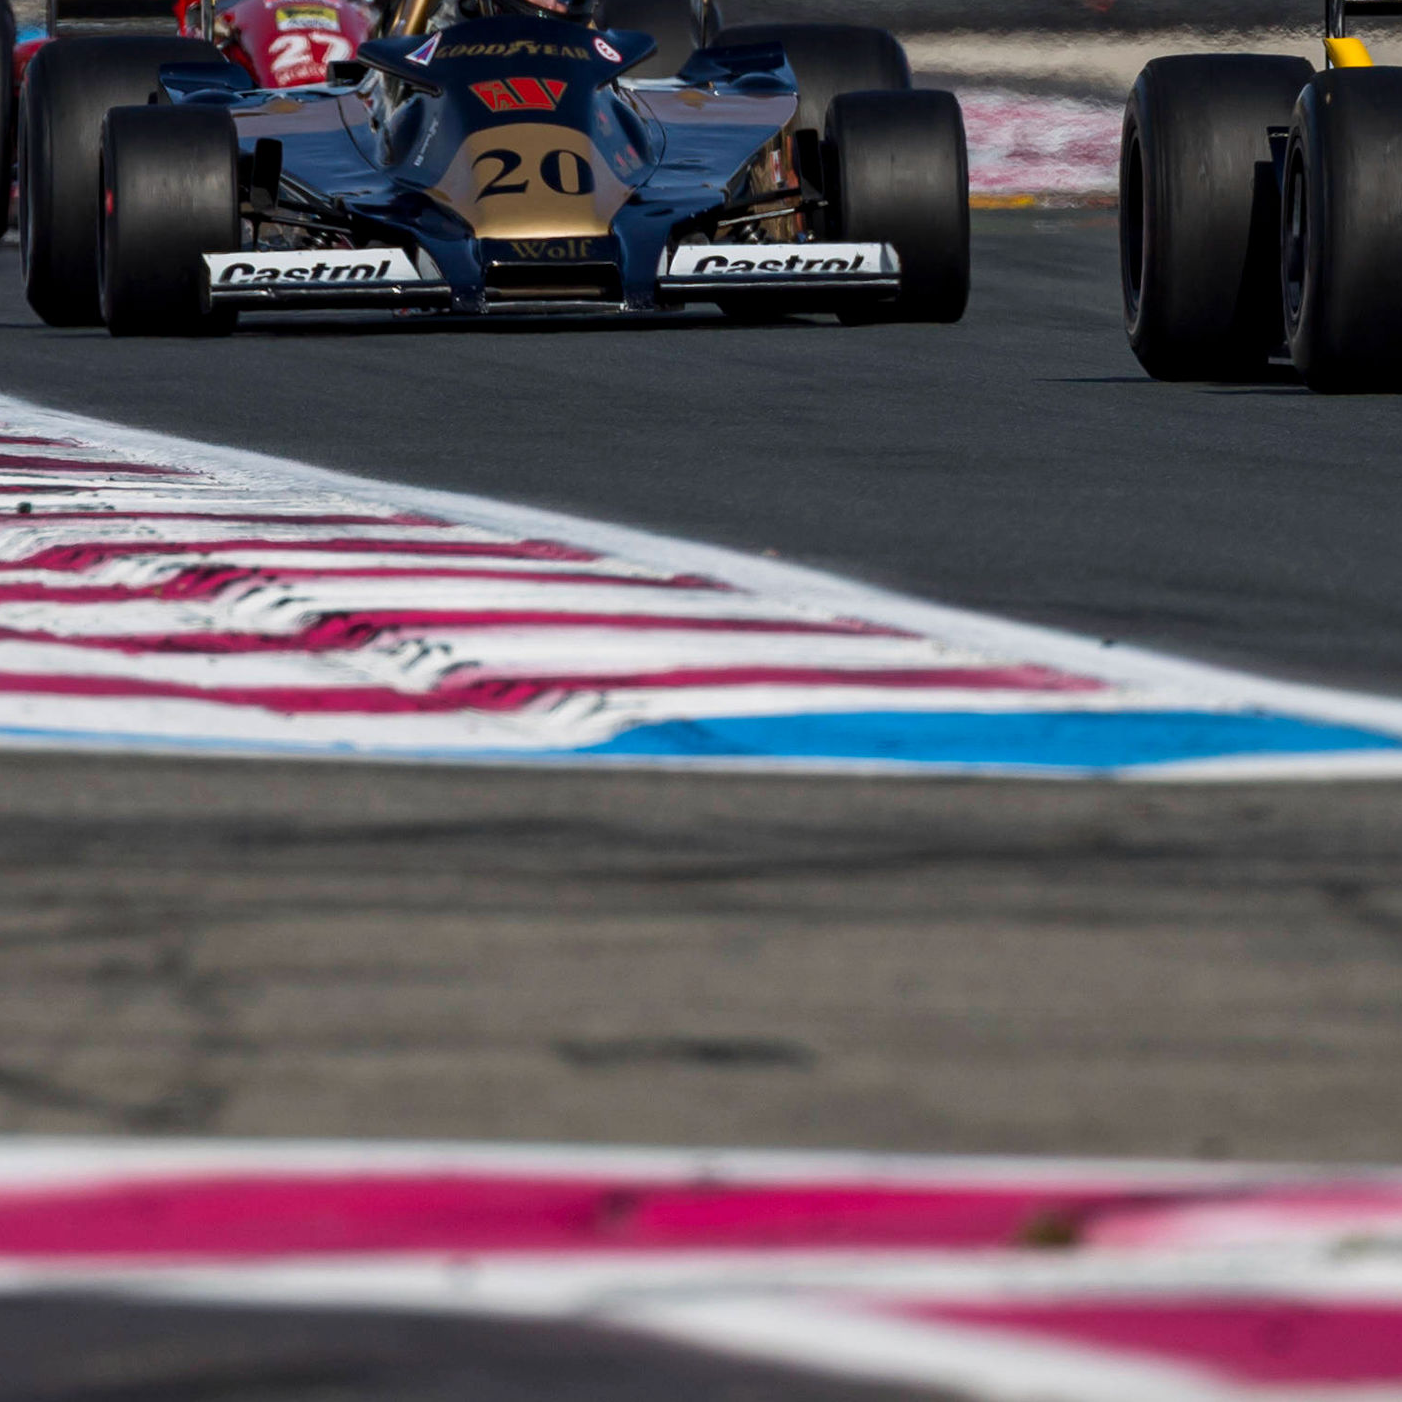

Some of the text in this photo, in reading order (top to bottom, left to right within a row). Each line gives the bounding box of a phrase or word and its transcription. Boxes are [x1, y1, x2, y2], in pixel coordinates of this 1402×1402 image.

[268, 31, 353, 72] 27
[436, 41, 591, 61] GOODYEAR
[471, 149, 595, 203] 20
[510, 241, 593, 259] Wolf
